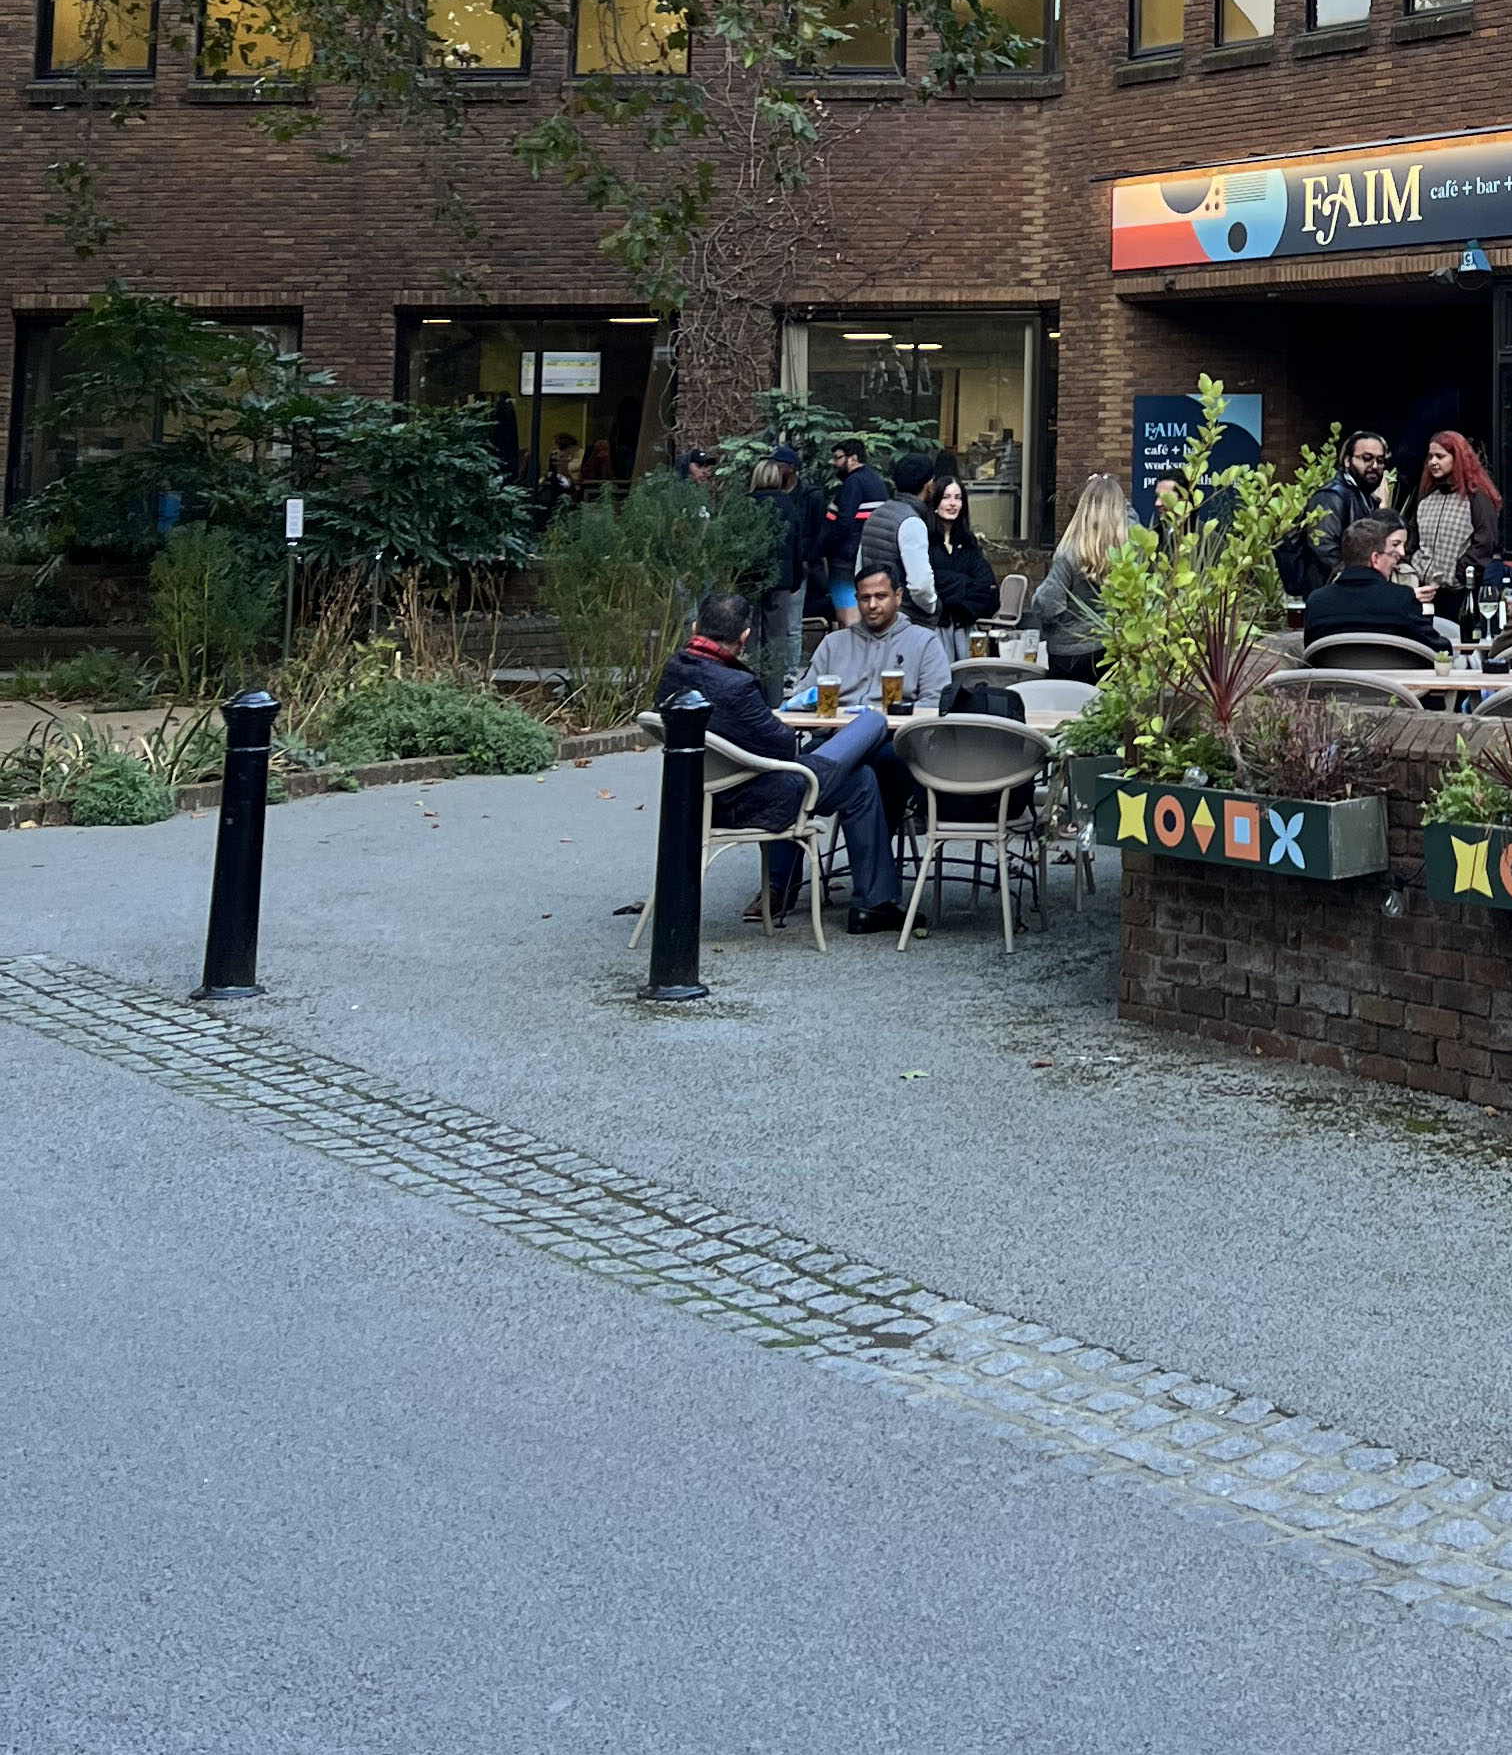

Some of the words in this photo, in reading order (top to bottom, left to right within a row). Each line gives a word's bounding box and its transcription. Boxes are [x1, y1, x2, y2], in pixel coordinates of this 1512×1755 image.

[1430, 179, 1459, 200] café
[1476, 176, 1500, 195] bar
[1301, 164, 1424, 246] FAIM
[1144, 422, 1188, 441] FAIM
[1144, 444, 1169, 456] café
